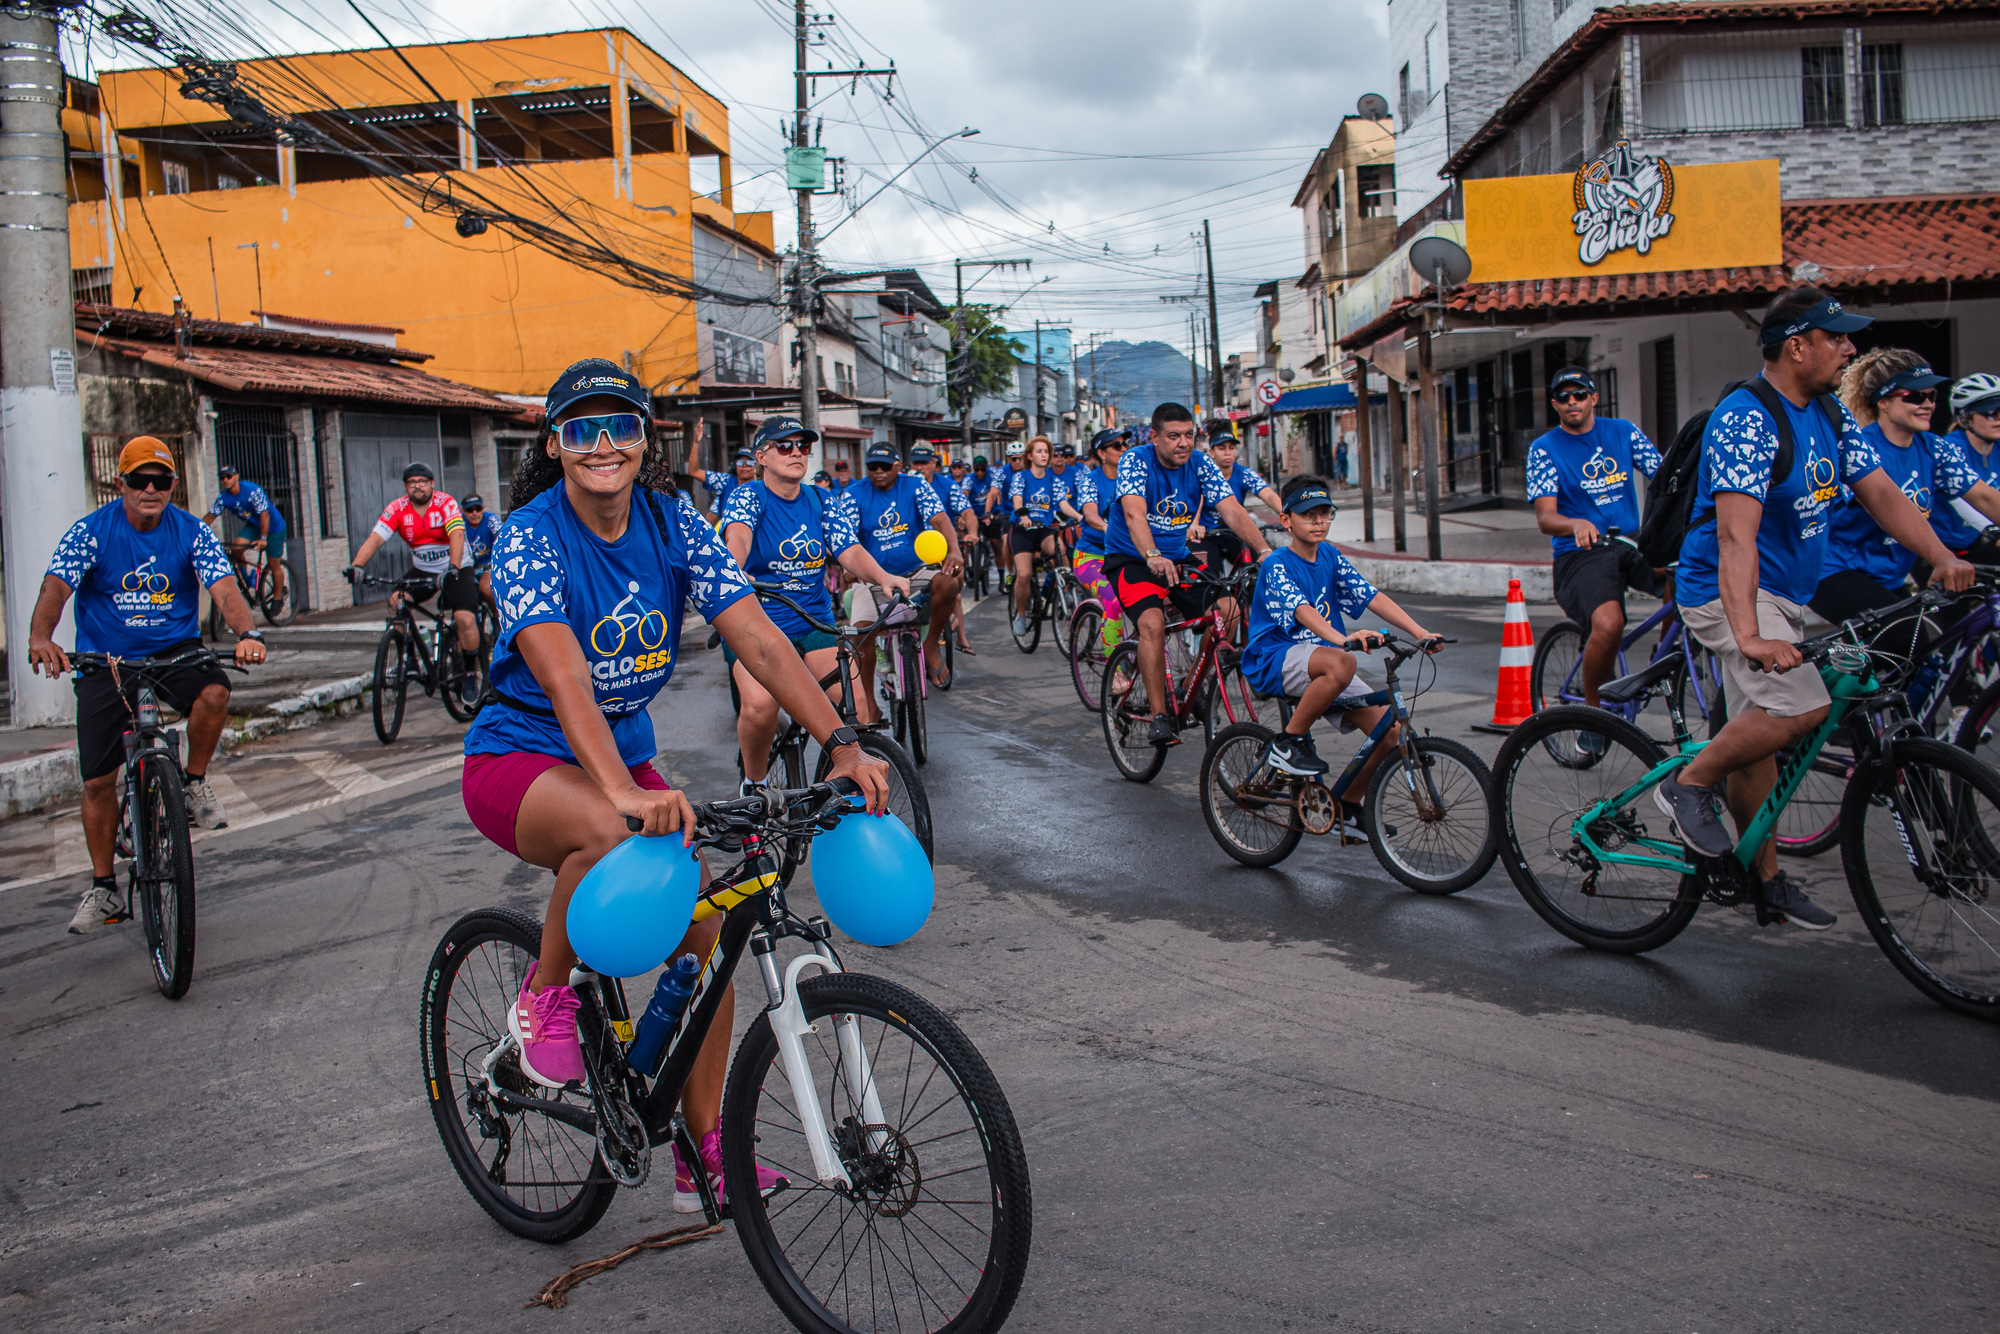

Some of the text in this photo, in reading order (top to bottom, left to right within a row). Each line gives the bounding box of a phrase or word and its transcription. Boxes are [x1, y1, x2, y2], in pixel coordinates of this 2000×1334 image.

[1572, 208, 1612, 234] Bar
[1620, 213, 1638, 227] dos
[1579, 210, 1675, 264] Chefes
[590, 376, 629, 388] CICLOSESC
[429, 511, 444, 528] 12
[442, 500, 460, 516] 12
[586, 646, 672, 680] ICLOSES
[592, 668, 666, 691] VER MAIS A CIDADE
[426, 968, 441, 1003] PRO
[425, 1014, 436, 1079] SCORPION
